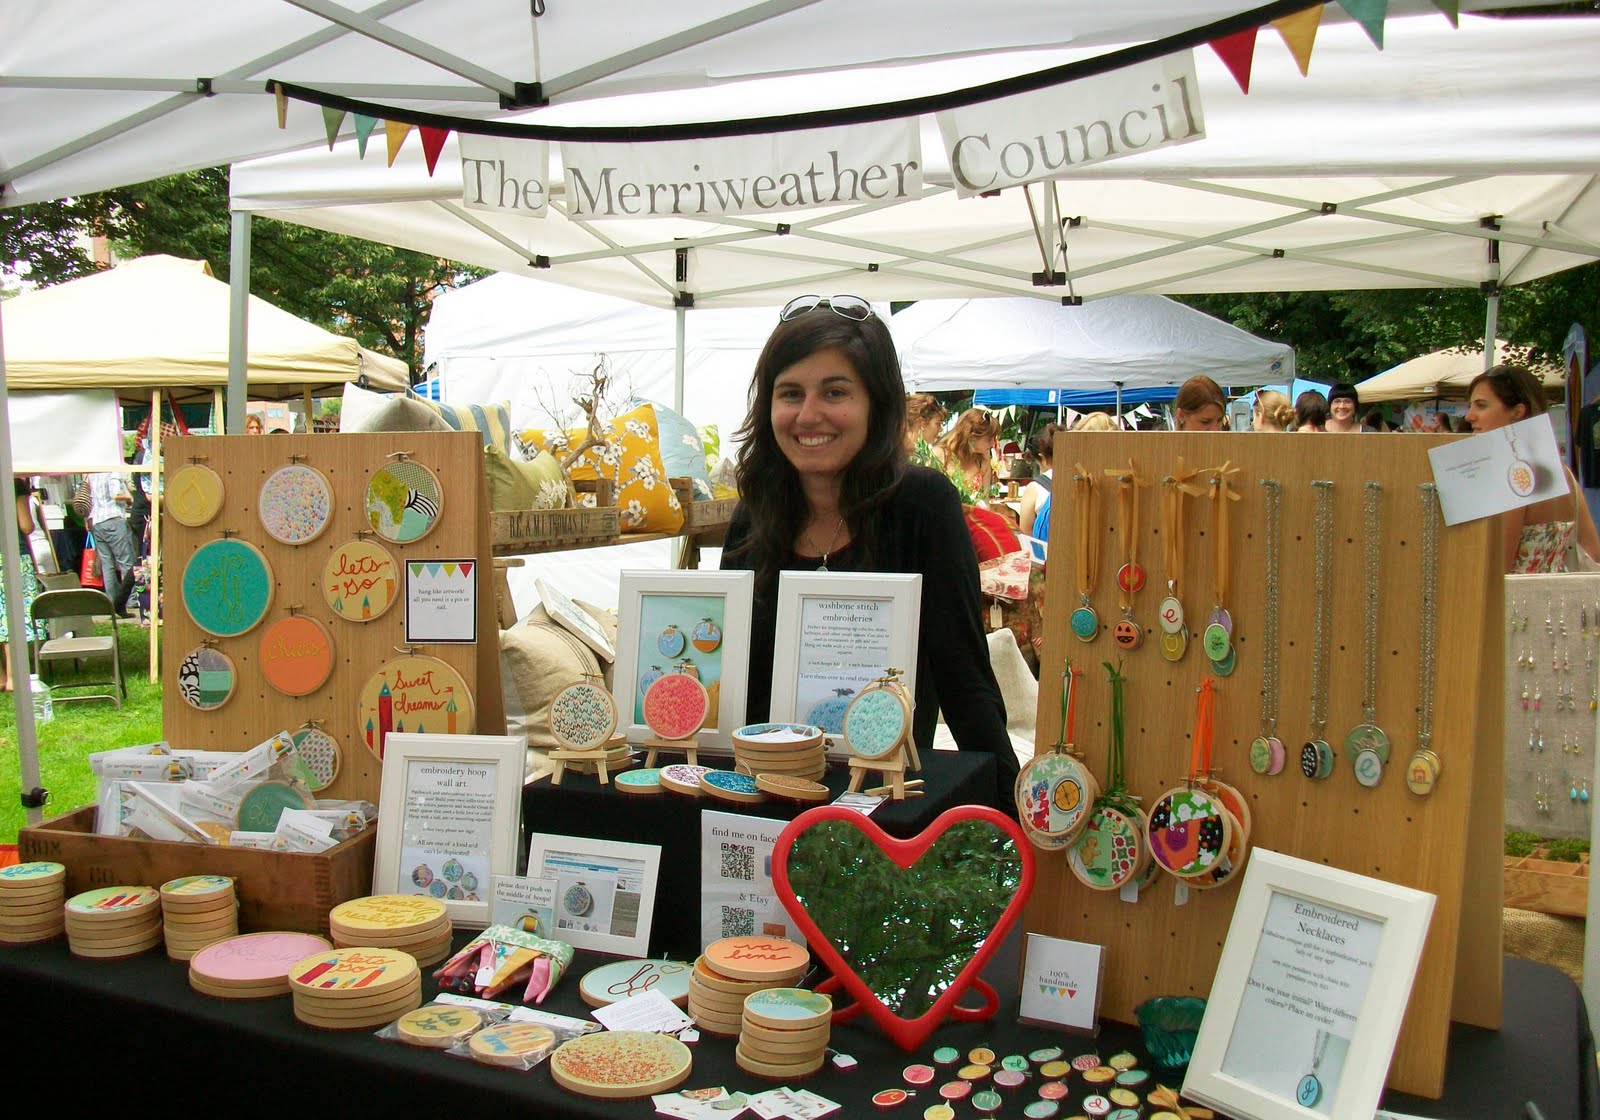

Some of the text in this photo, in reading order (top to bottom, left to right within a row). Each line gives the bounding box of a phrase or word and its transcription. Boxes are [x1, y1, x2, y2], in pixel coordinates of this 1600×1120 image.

[462, 76, 1202, 216] The Merriweather Council
[818, 602, 879, 611] wishbone stitch
[822, 614, 873, 622] embroideries
[392, 670, 440, 695] Sweet
[394, 692, 447, 714] dreams
[421, 766, 487, 778] embroidery hoop
[712, 827, 729, 837] find
[760, 833, 779, 844] face
[534, 894, 551, 903] hoops!
[739, 892, 770, 906] & Etsy
[1294, 903, 1359, 931] Embroidered
[1296, 921, 1346, 945] Necklaces
[1050, 970, 1070, 978] 100%
[1039, 976, 1078, 989] handmade
[1288, 1004, 1304, 1015] Place
